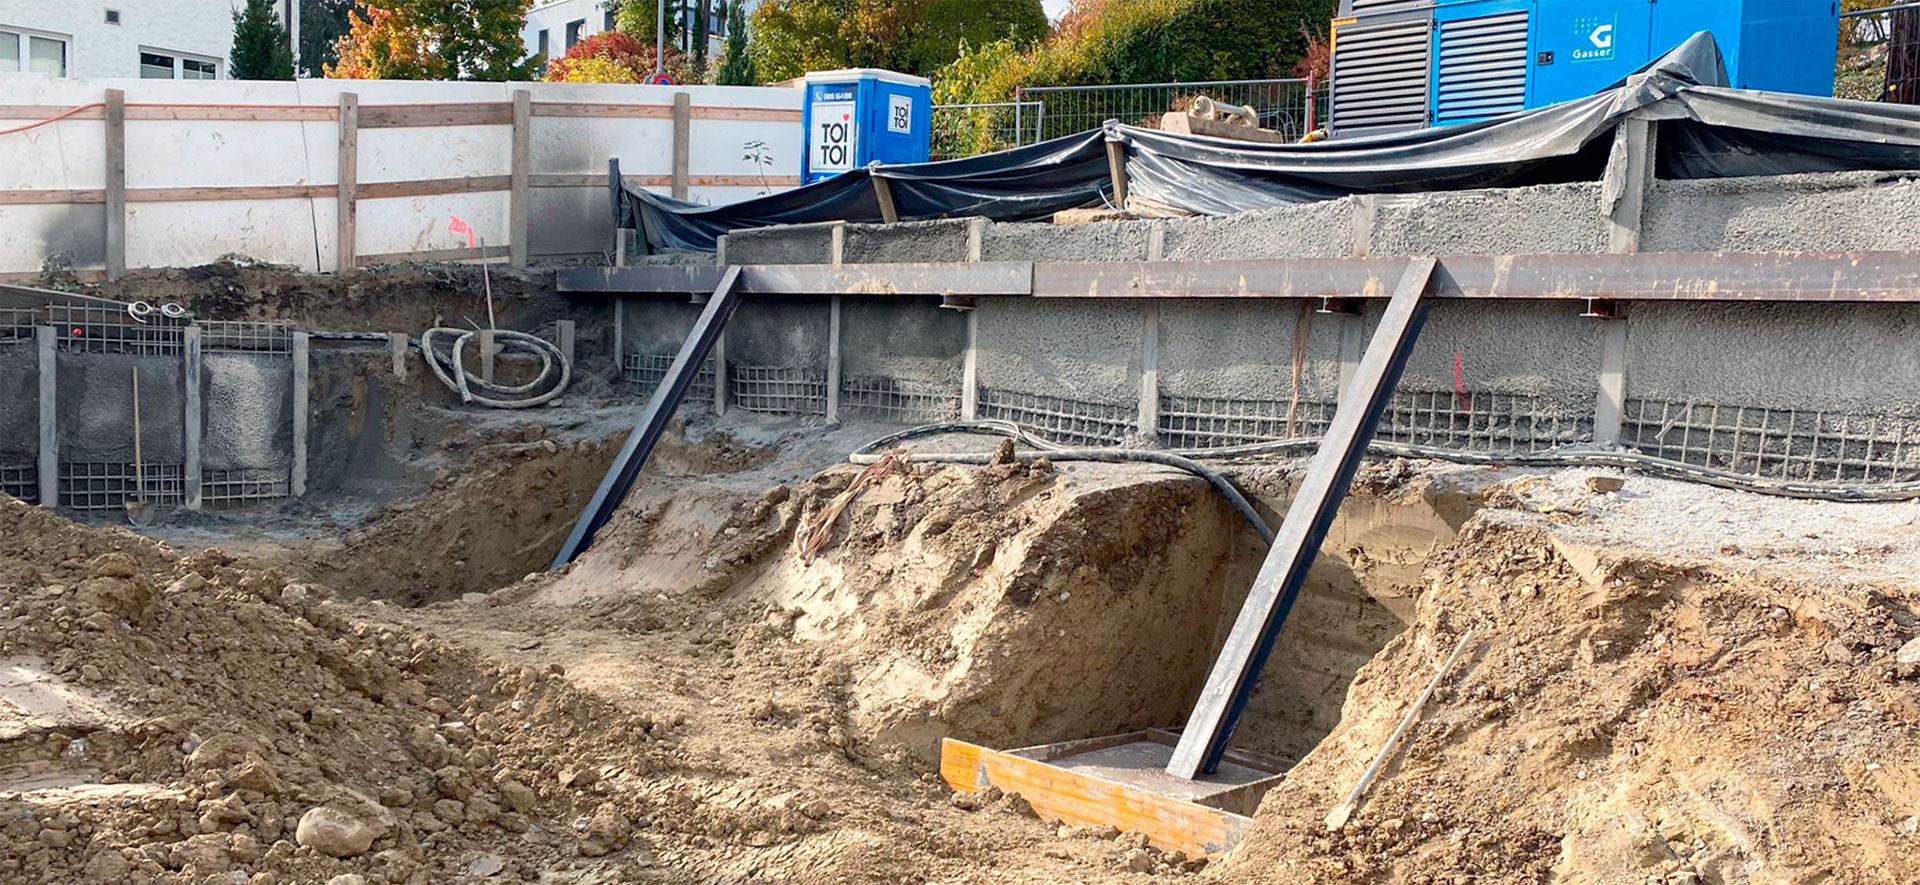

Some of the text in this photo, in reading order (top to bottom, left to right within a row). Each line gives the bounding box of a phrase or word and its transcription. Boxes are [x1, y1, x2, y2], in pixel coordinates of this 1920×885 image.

[1572, 48, 1612, 59] Gasser
[895, 106, 908, 118] TOI
[894, 118, 908, 129] TOI
[821, 123, 848, 143] TOI
[821, 145, 847, 165] TOI
